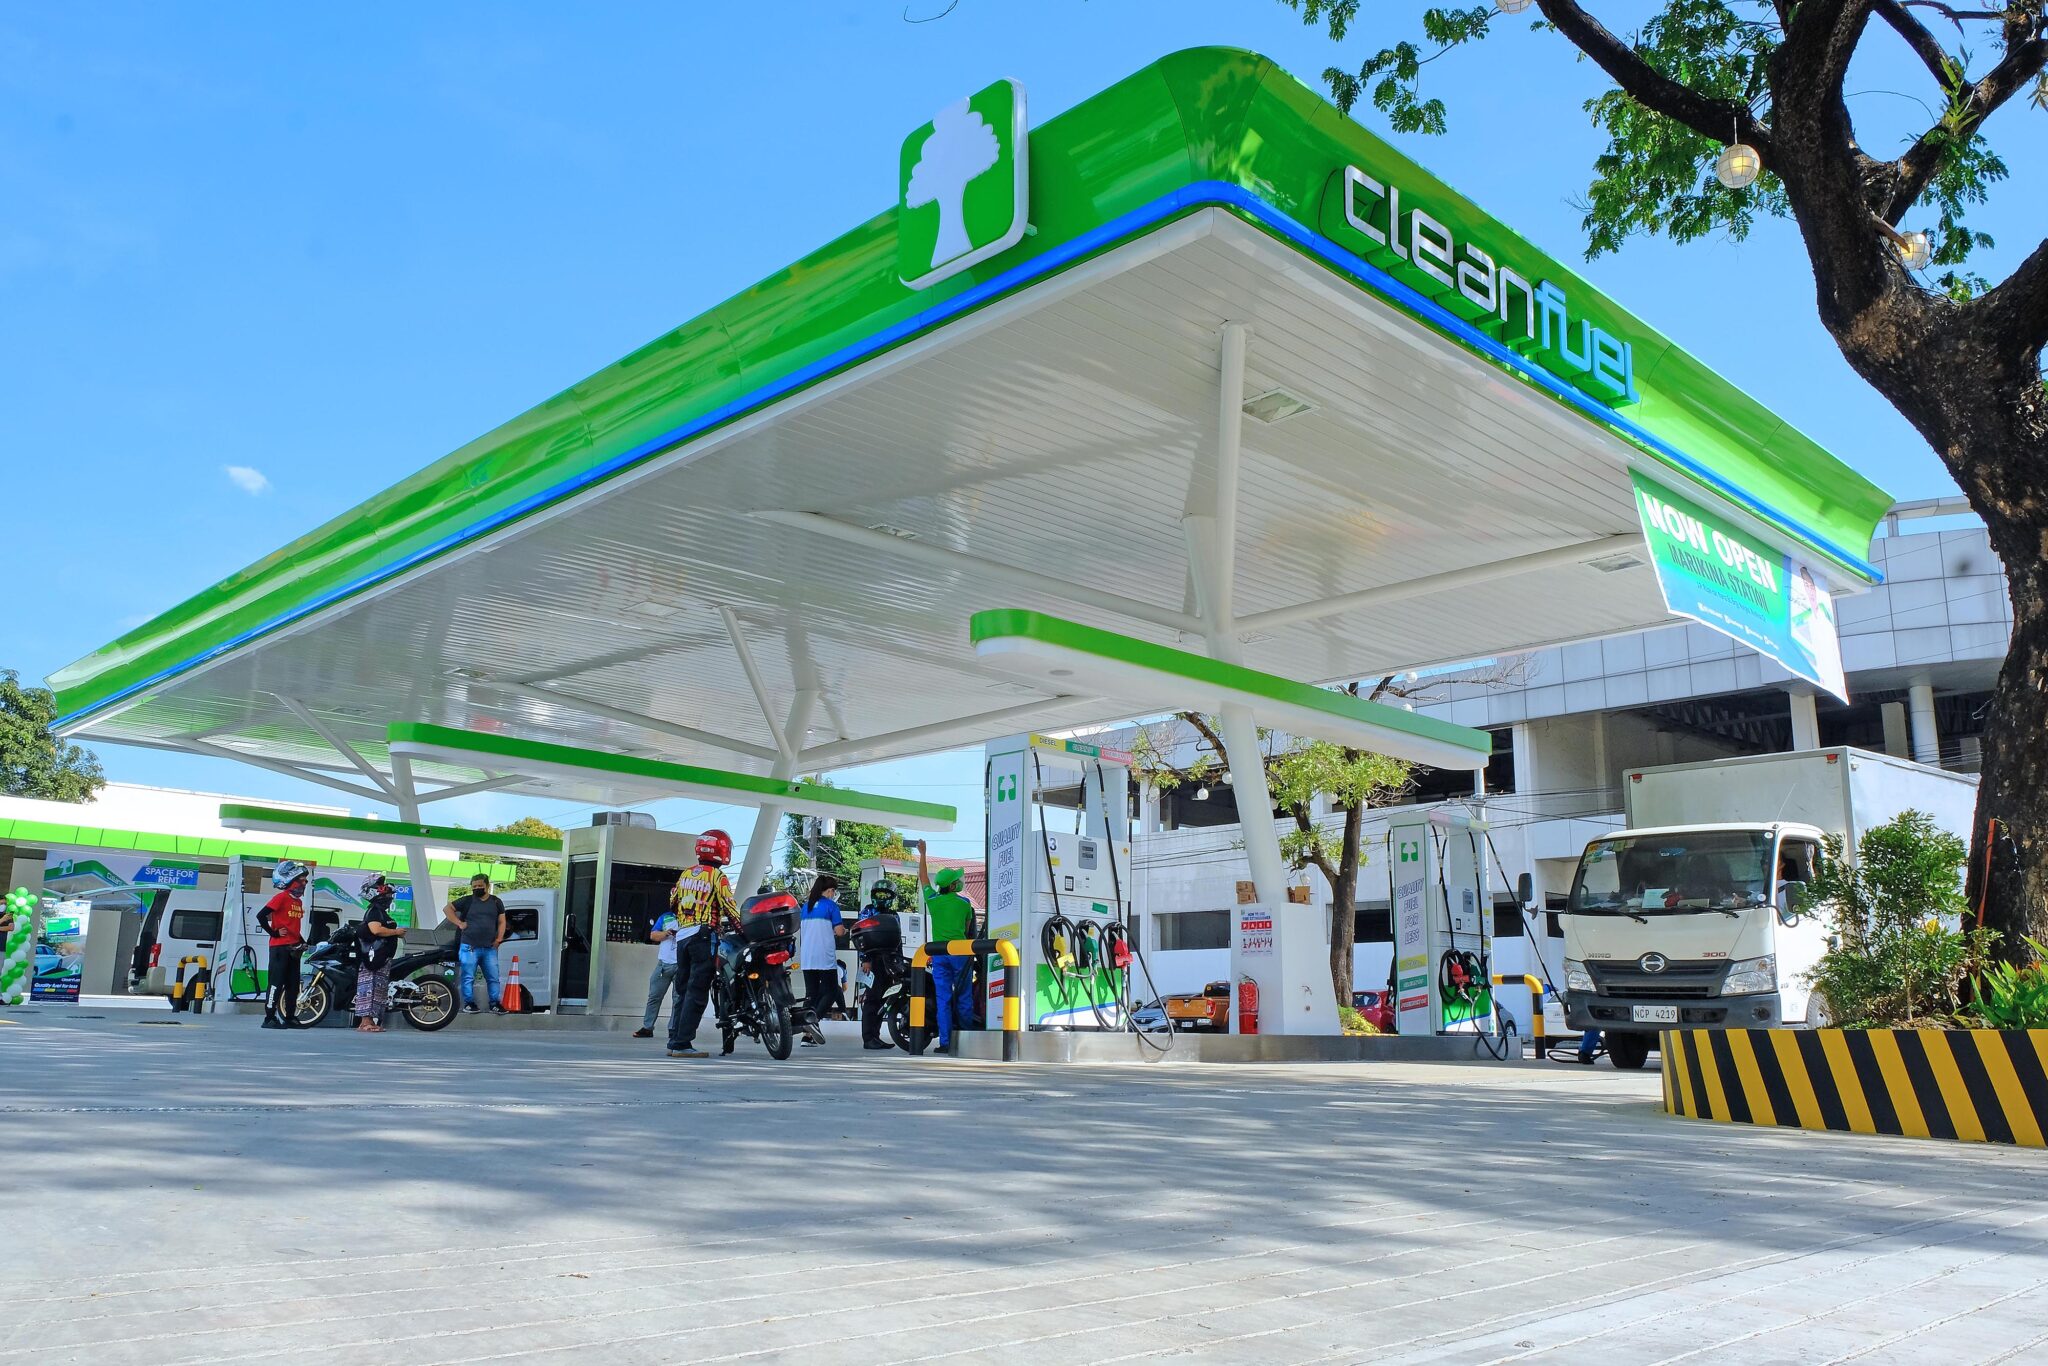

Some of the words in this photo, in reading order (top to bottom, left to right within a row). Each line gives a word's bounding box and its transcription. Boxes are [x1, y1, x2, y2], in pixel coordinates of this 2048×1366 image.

[1641, 491, 1710, 556] NOW
[1712, 530, 1779, 594] OPEN
[1668, 542, 1728, 588] MARIKINA
[1728, 572, 1769, 615] STATION
[1039, 737, 1057, 747] DIESEL
[992, 822, 1021, 851] QUALITY
[1049, 837, 1057, 851] 3
[998, 846, 1014, 868] FUEL
[145, 867, 174, 877] SPACE
[175, 869, 194, 879] FOR
[157, 876, 180, 884] RENT
[998, 868, 1014, 889] FOR
[1397, 878, 1425, 899] QUALITY
[997, 888, 1014, 910] LESS
[1403, 896, 1419, 912] FUEL
[1404, 913, 1419, 929] FOR
[1405, 928, 1420, 945] LESS
[1634, 1009, 1650, 1019] NCP
[1655, 1009, 1676, 1019] 4219
